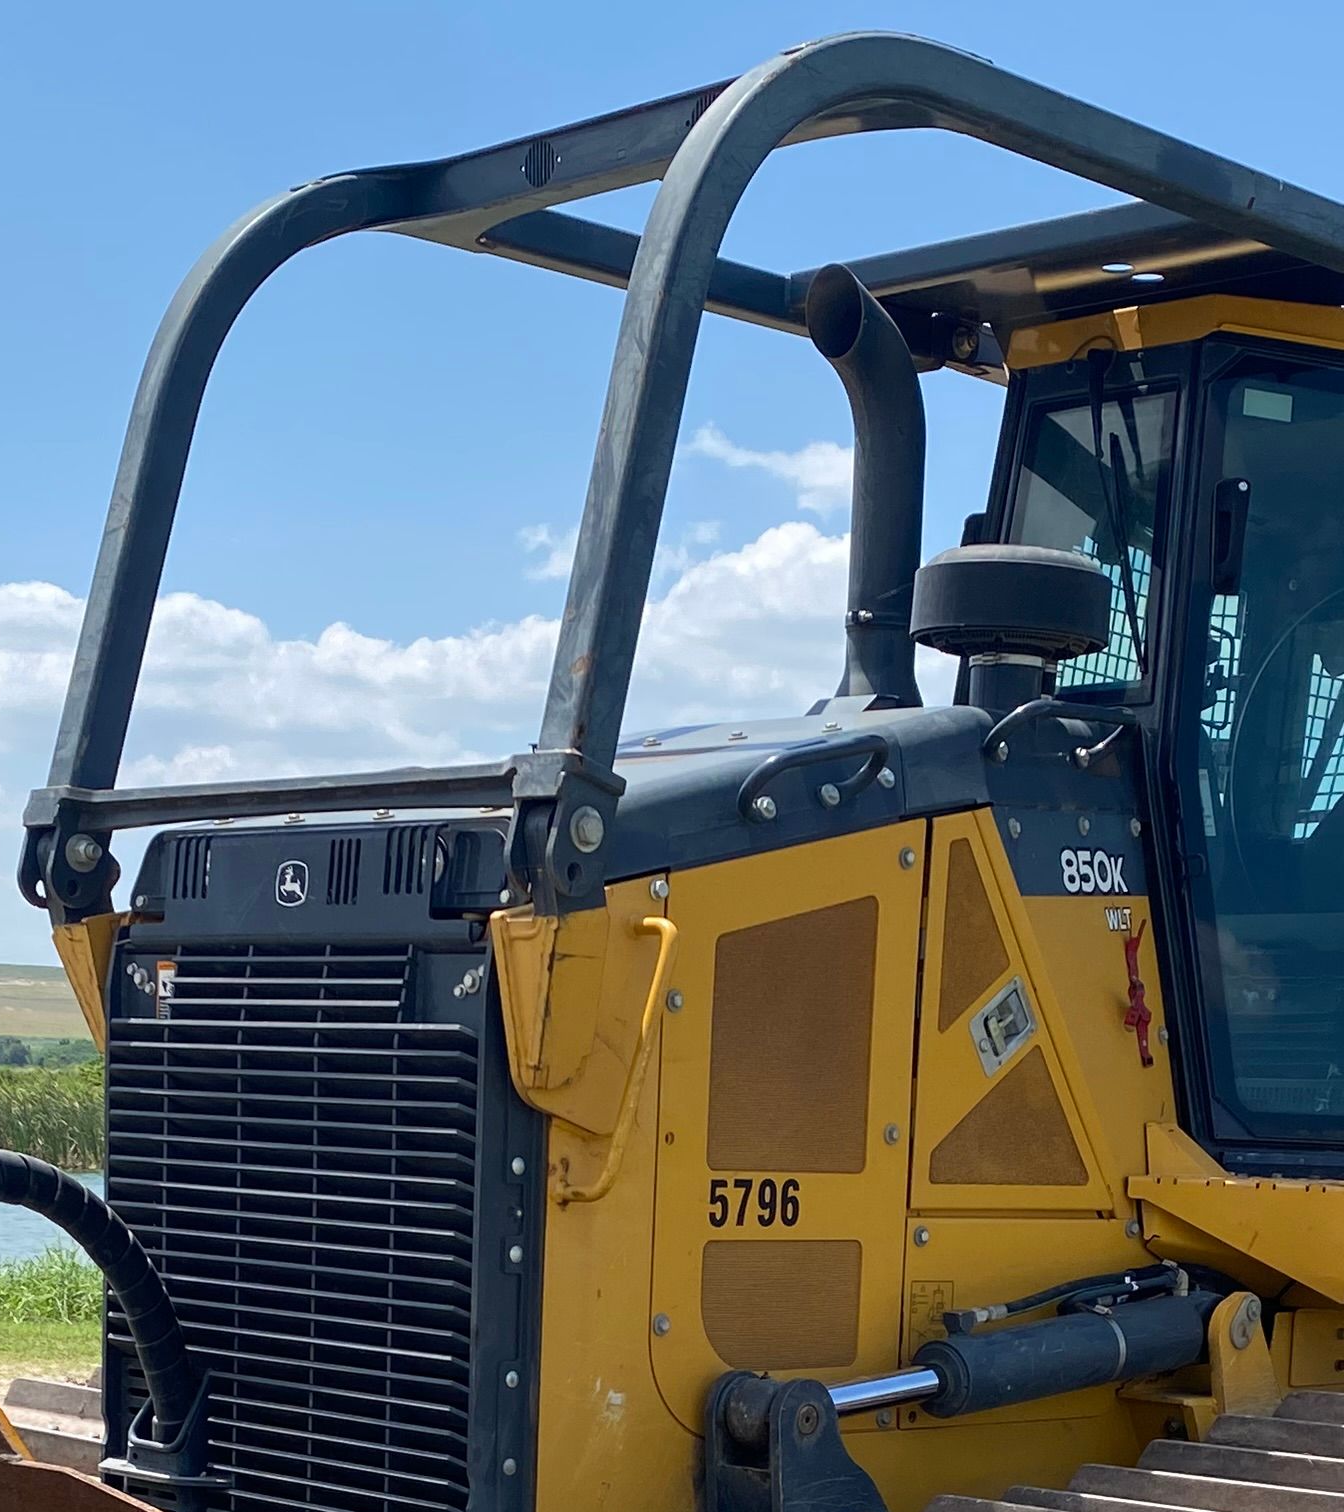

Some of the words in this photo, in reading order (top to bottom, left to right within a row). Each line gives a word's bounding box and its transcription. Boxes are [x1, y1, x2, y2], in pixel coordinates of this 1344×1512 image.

[1059, 847, 1130, 894] 850K
[1104, 907, 1132, 931] WLT
[708, 1178, 800, 1228] 5796
